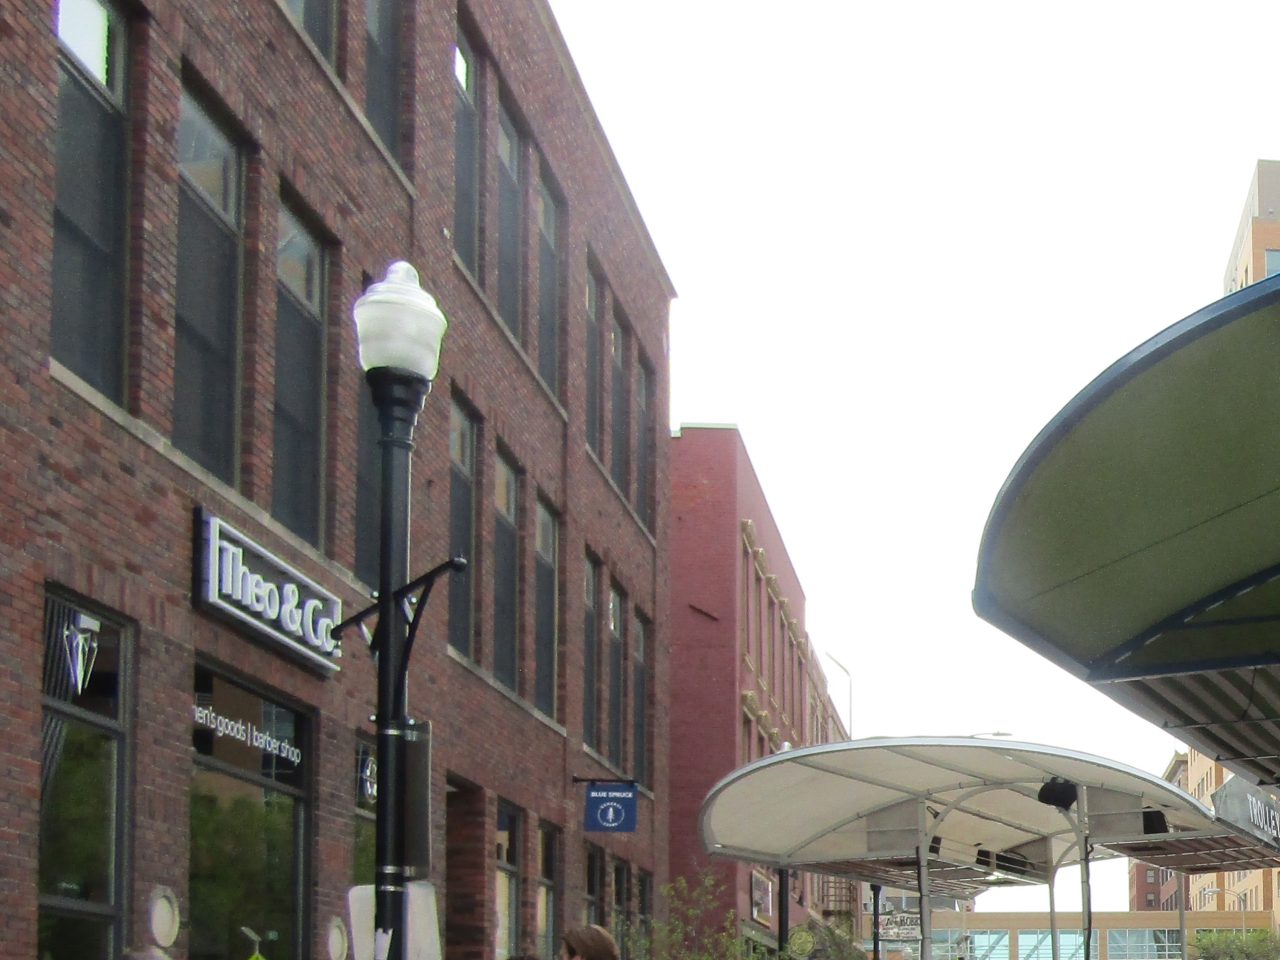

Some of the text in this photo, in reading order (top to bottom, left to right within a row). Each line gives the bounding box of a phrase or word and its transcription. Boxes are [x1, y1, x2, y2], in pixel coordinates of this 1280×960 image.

[219, 539, 280, 619] Theo
[281, 584, 303, 636] &
[217, 716, 246, 741] goods
[253, 725, 280, 754] barber
[281, 739, 302, 767] shop
[1247, 794, 1280, 838] TROLLEY
